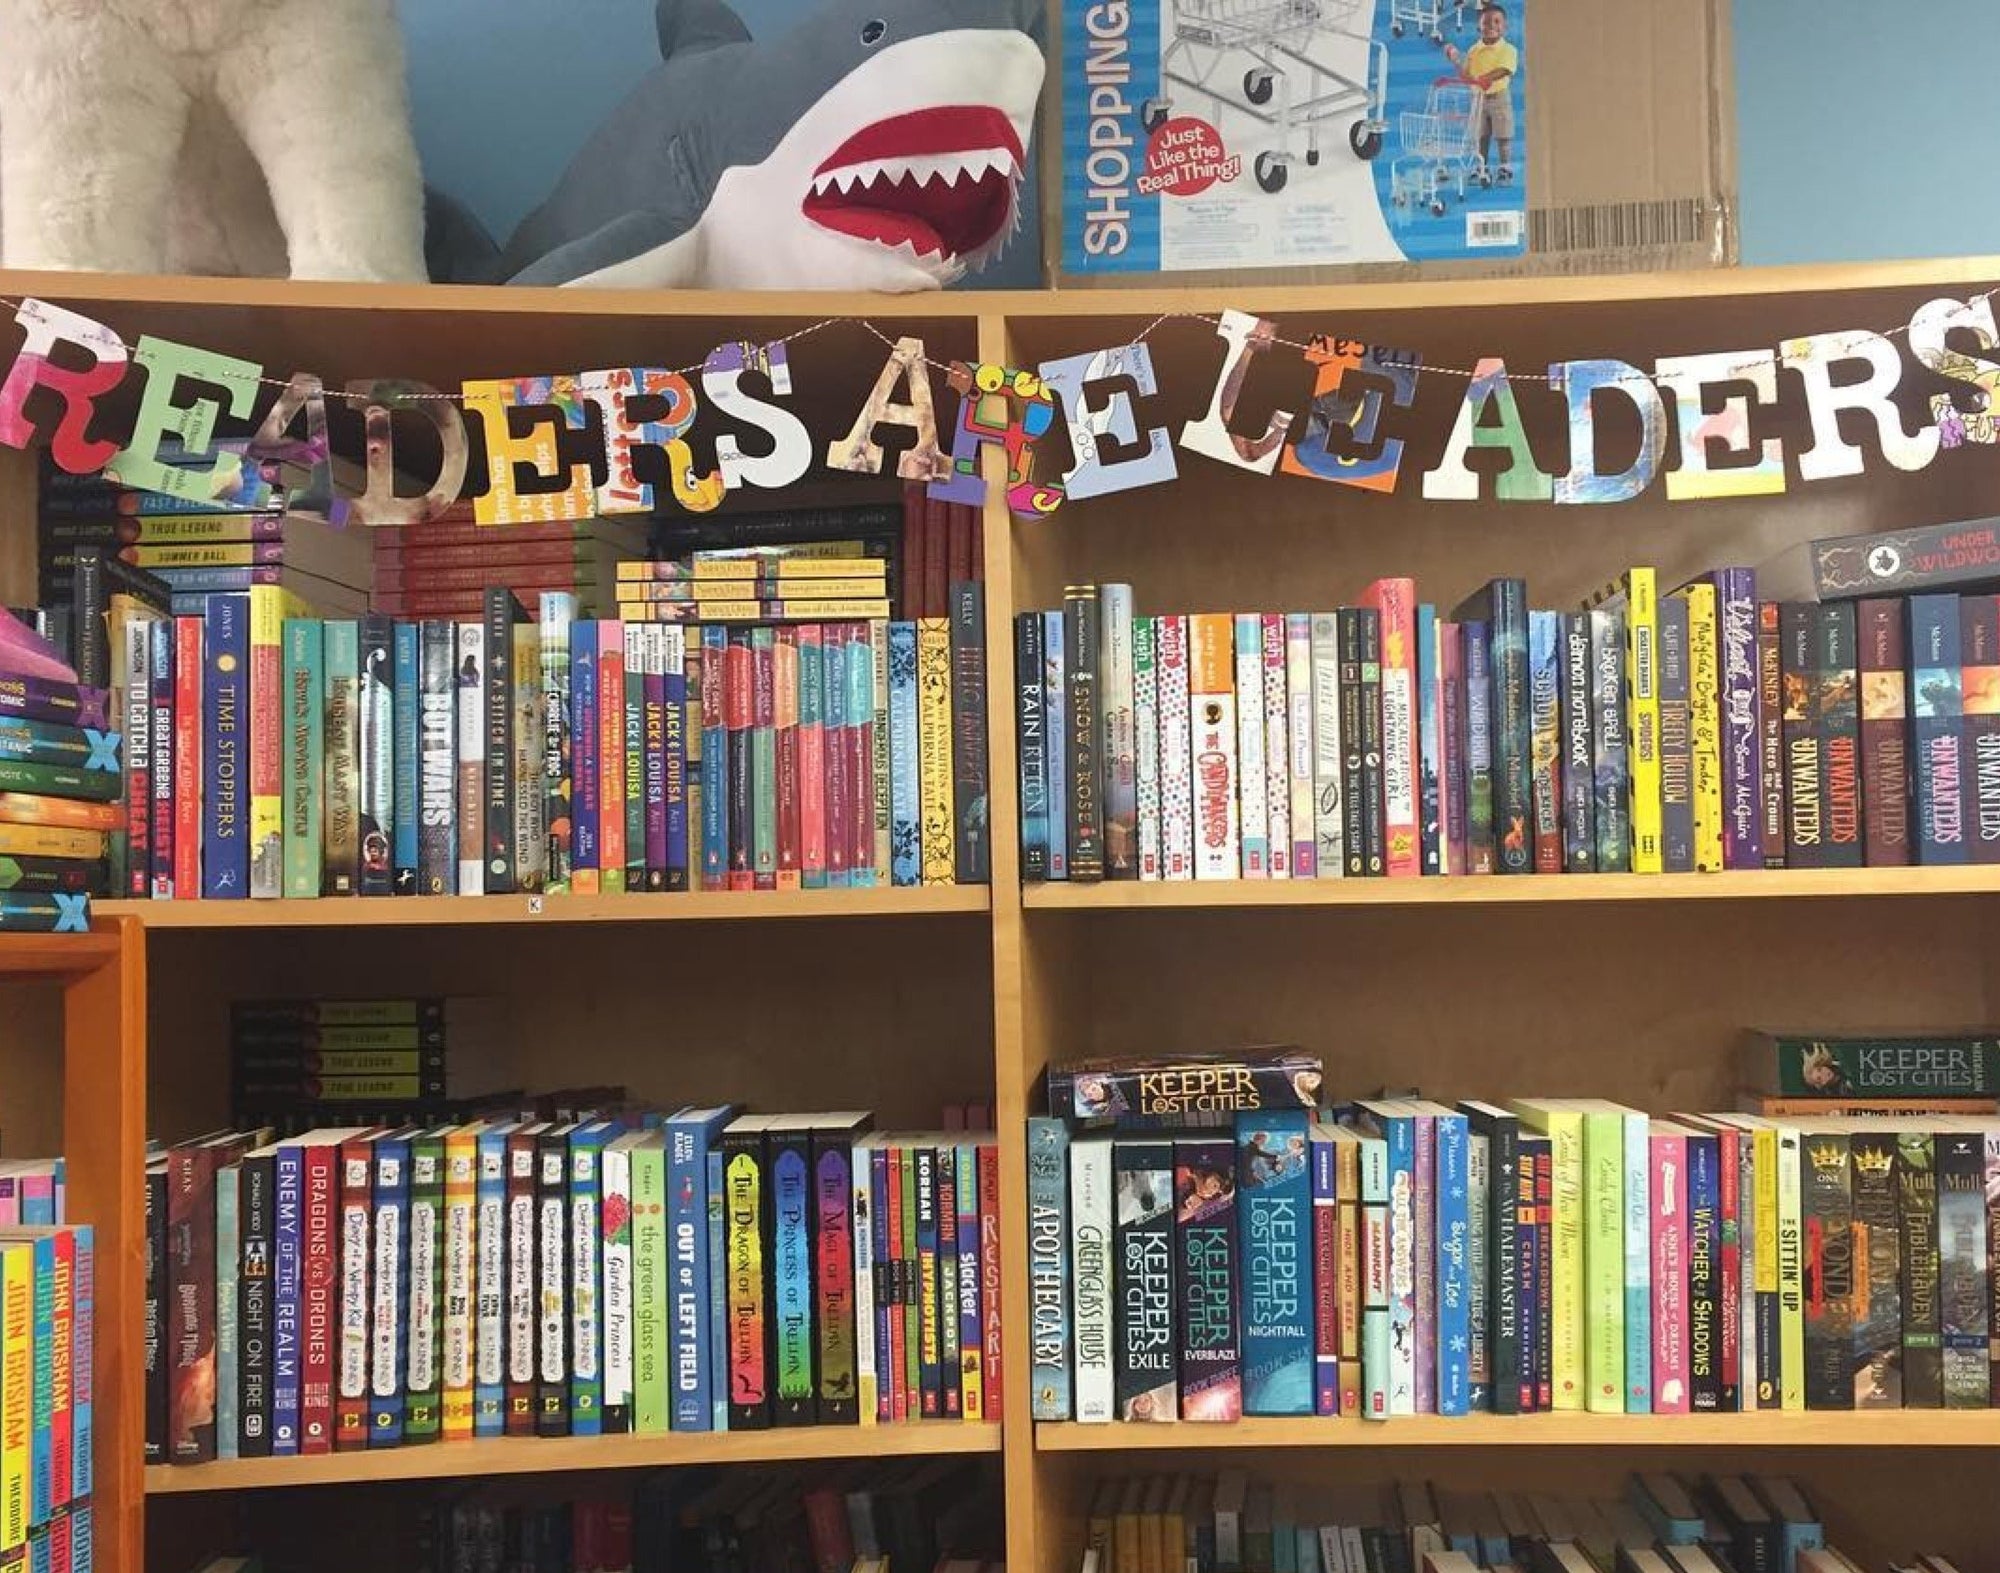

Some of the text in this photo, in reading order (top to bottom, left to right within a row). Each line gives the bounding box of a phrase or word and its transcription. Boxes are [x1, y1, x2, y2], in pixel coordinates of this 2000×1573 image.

[1084, 0, 1133, 256] SHOPPING
[1160, 125, 1204, 148] Just
[1136, 156, 1241, 195] Real Thing!
[1150, 142, 1221, 171] Like the
[0, 295, 2000, 526] READERS ARE LEADERS
[151, 522, 176, 534] TRUE
[1944, 528, 1996, 551] UNDER
[204, 551, 226, 561] BALL
[960, 593, 973, 626] KELLY
[1136, 628, 1149, 662] wish
[1164, 625, 1178, 661] wish
[1266, 623, 1278, 660] wish
[130, 680, 148, 699] TO
[546, 691, 560, 733] CHARLIE
[1074, 686, 1090, 744] SNOW
[218, 603, 235, 839] JONES TIME STOPPERS
[491, 694, 505, 745] STITCH
[626, 703, 640, 737] JACK
[646, 701, 661, 738] JACK
[1206, 731, 1219, 750] THE
[491, 752, 505, 768] IN
[923, 695, 936, 813] CALPURNIA TATE
[1022, 684, 1045, 813] RAIN REIGN
[1384, 690, 1400, 805] LIGHTNING GIRL
[1397, 702, 1410, 798] MISCALCULATIONS
[1661, 700, 1688, 803] FIREFLY HOLLOW
[1698, 747, 1716, 793] Tender
[1765, 737, 1779, 768] Hero
[423, 748, 451, 826] WARS
[491, 774, 505, 808] TIME
[627, 750, 641, 800] LOUISA
[647, 752, 661, 803] LOUISA
[1078, 771, 1092, 823] ROSE
[1734, 742, 1750, 840] Sarah McGuire
[1790, 738, 1820, 845] UNWANTEDS
[1829, 736, 1857, 842] UNWANTEDS
[1931, 736, 1962, 843] UNWANTEDS
[1767, 792, 1780, 835] Crown
[530, 900, 540, 911] K
[1139, 1067, 1260, 1097] KEEPER
[1858, 1048, 1969, 1071] KEEPER
[1858, 1069, 1974, 1088] LOST CITIES
[1140, 1091, 1260, 1115] LOST CITIES
[348, 1213, 364, 1245] Diary
[1691, 1207, 1714, 1282] WATCHER
[278, 1160, 297, 1376] ENEMY OF THE REALM
[309, 1165, 328, 1365] DRAGONS VS DRONES
[607, 1256, 625, 1308] Garden
[919, 1156, 937, 1364] KORMAN HYPNOTISTS
[1251, 1197, 1271, 1324] LOST CITIES
[1270, 1197, 1297, 1322] KEEPER
[1443, 1220, 1467, 1308] Sugar Ice
[1500, 1199, 1516, 1338] WHALEMASTER
[1781, 1229, 1799, 1312] SITTIN' UP
[1906, 1212, 1932, 1324] FABLEHAVEN
[247, 1281, 263, 1332] NIGHT
[346, 1270, 360, 1306] Wimpy
[637, 1226, 658, 1383] the green glass sea
[677, 1223, 697, 1391] OUT OF LEFT FIELD
[943, 1267, 956, 1350] JACKPOT
[982, 1215, 1000, 1379] RESTART
[1031, 1204, 1063, 1369] APOTHECARY
[1076, 1225, 1106, 1369] GREENGLASS HOUSE
[1125, 1231, 1145, 1353] LOST CITIES
[1144, 1231, 1170, 1352] KEEPER
[1185, 1227, 1204, 1349] LOST CITIES
[1204, 1227, 1230, 1345] KEEPER
[53, 1256, 70, 1414] JOHN GRISHAM
[348, 1309, 361, 1327] Kid
[1248, 1325, 1306, 1337] NIGHTFALL
[1693, 1299, 1714, 1377] SHADOWS
[247, 1340, 263, 1368] ON
[1128, 1353, 1171, 1369] EXILE
[1184, 1350, 1236, 1360] EVERBLAZE
[5, 1280, 26, 1541] JOHN GRISHAM THEODORE
[247, 1374, 263, 1407] FIRE
